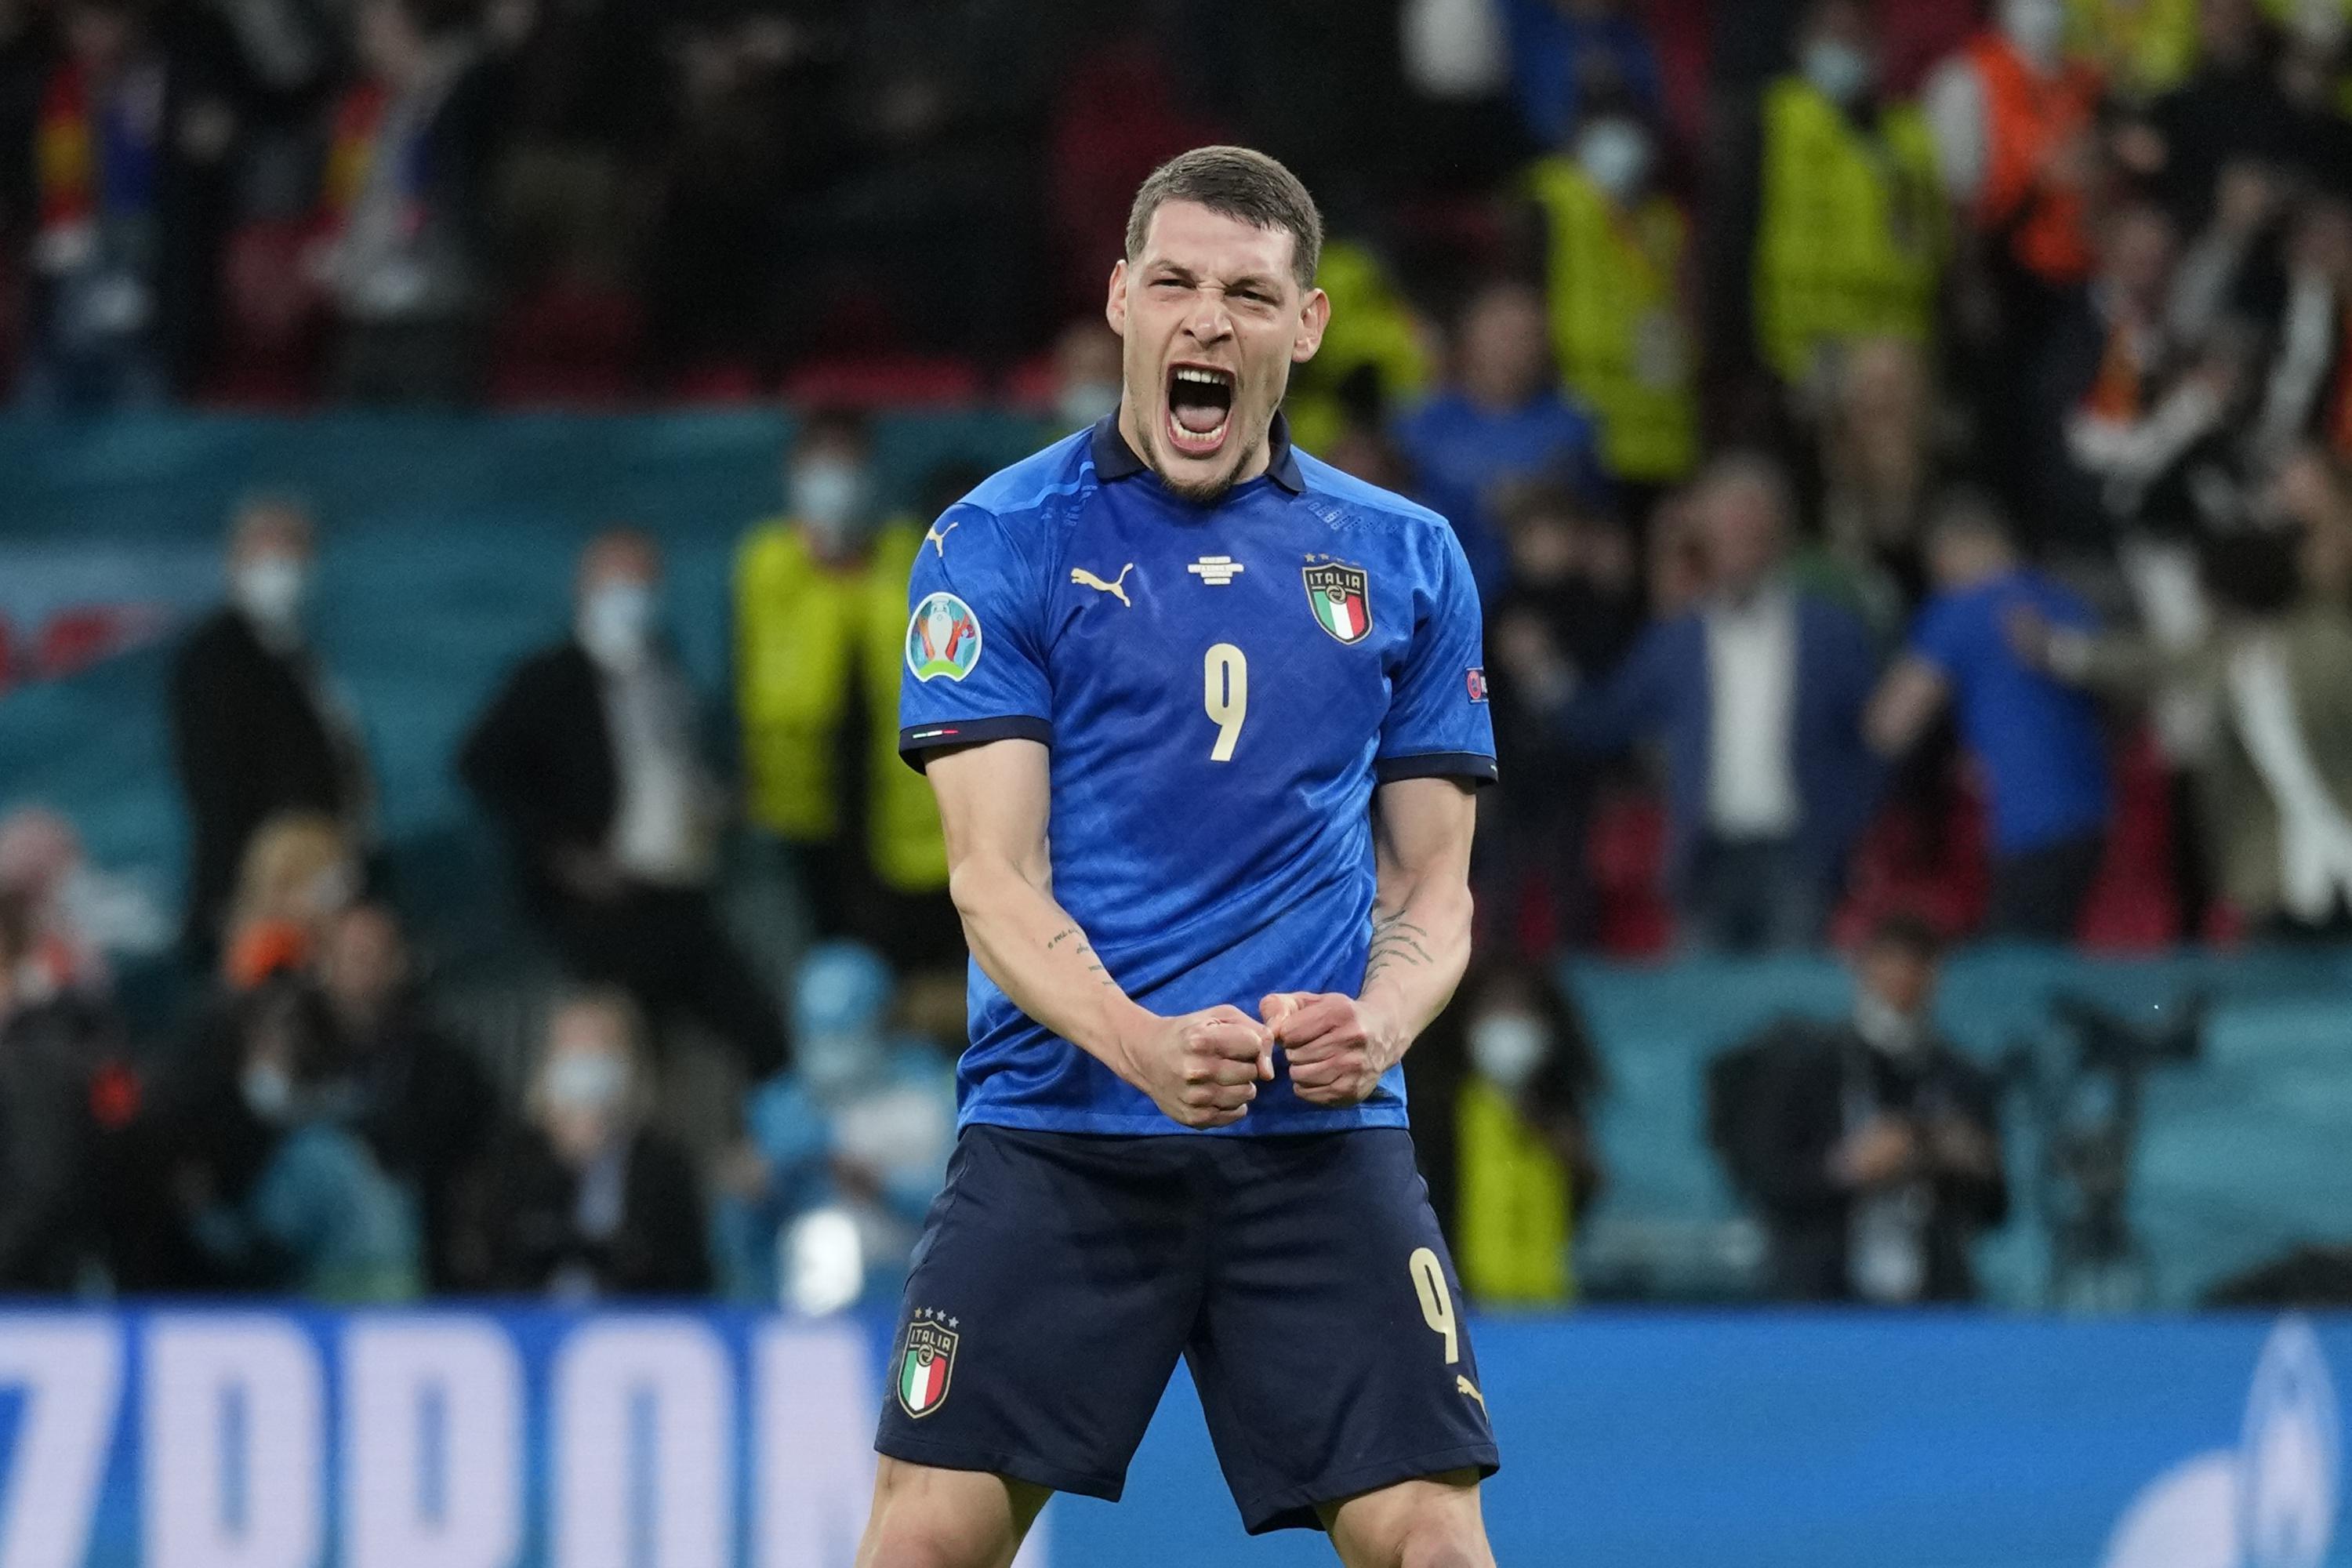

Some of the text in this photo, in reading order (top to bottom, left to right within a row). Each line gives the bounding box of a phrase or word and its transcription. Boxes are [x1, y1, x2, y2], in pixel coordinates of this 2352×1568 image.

[1308, 572, 1361, 589] ITALIA
[1204, 643, 1247, 762] 9
[910, 1329, 951, 1351] ITALIA
[1409, 1247, 1459, 1365] 9
